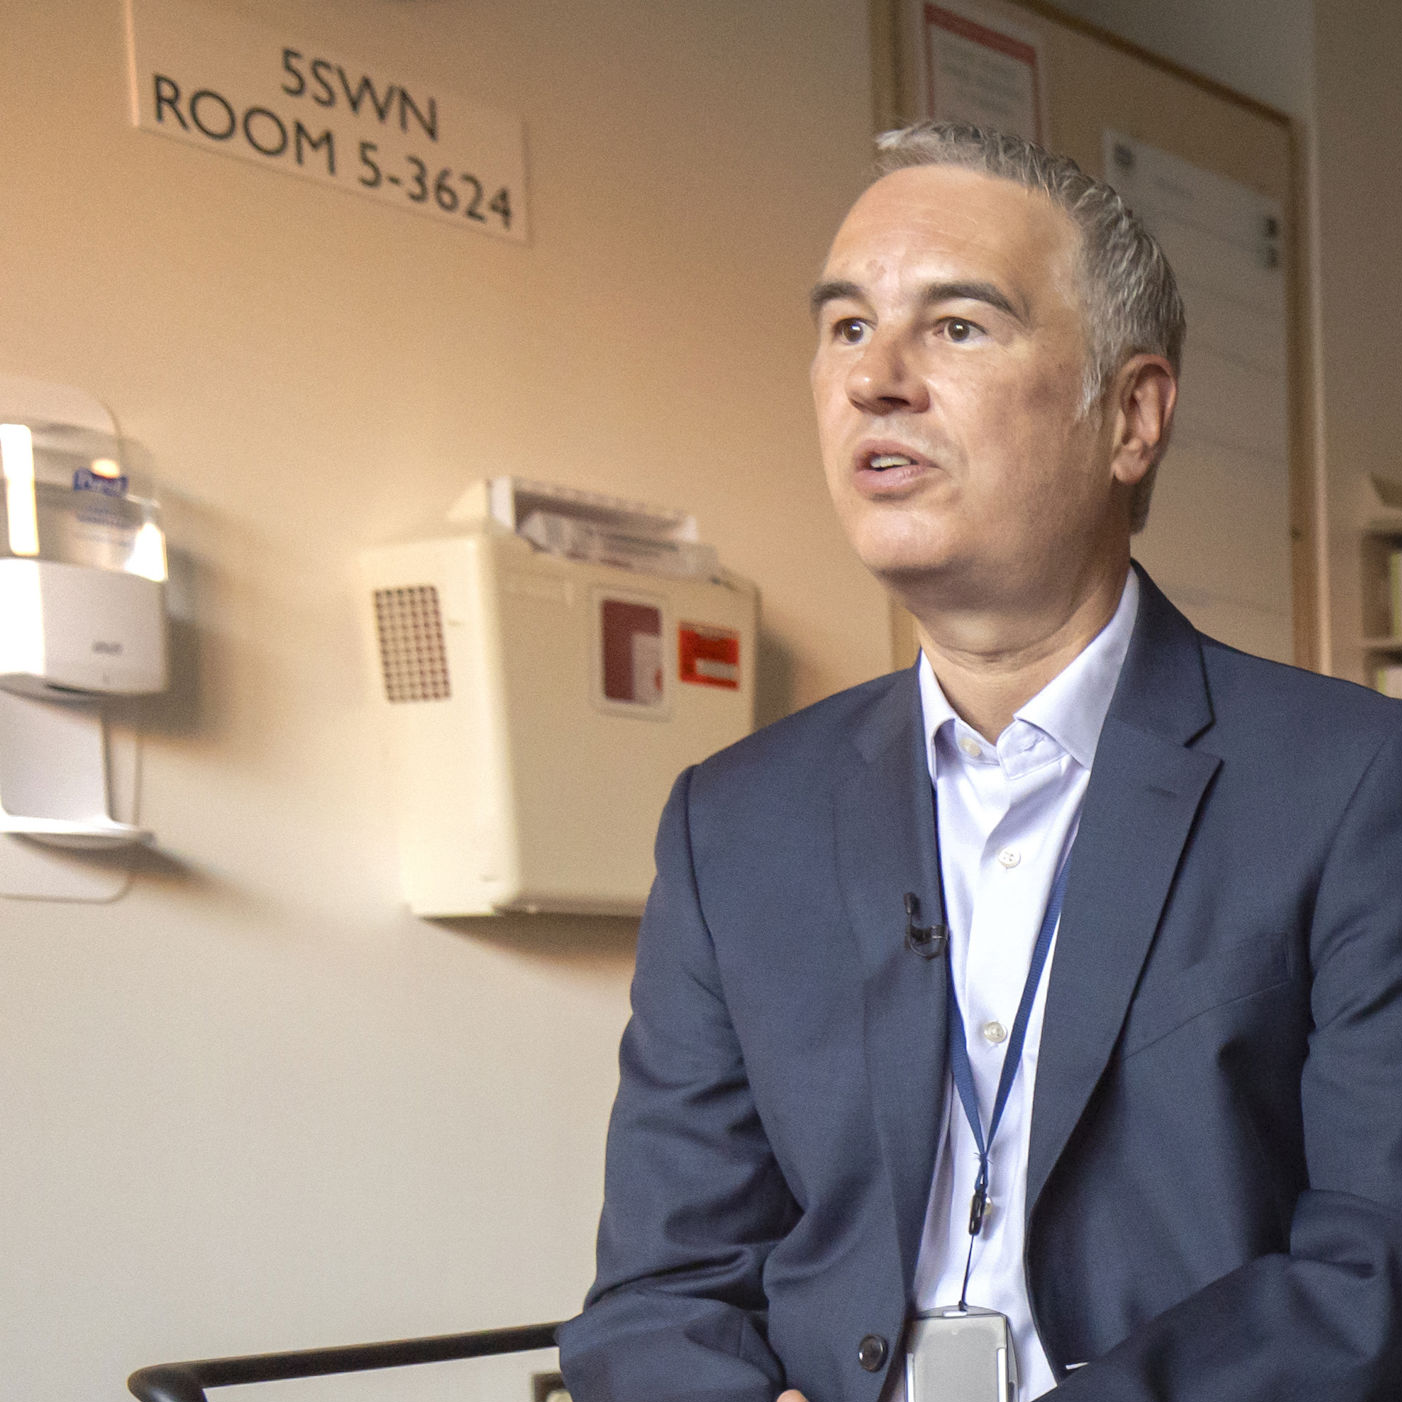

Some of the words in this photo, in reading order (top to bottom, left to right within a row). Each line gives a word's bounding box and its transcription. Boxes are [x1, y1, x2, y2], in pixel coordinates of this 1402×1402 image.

[154, 73, 335, 176] ROOM
[358, 141, 512, 230] 5-3624
[281, 48, 438, 142] 5SWN
